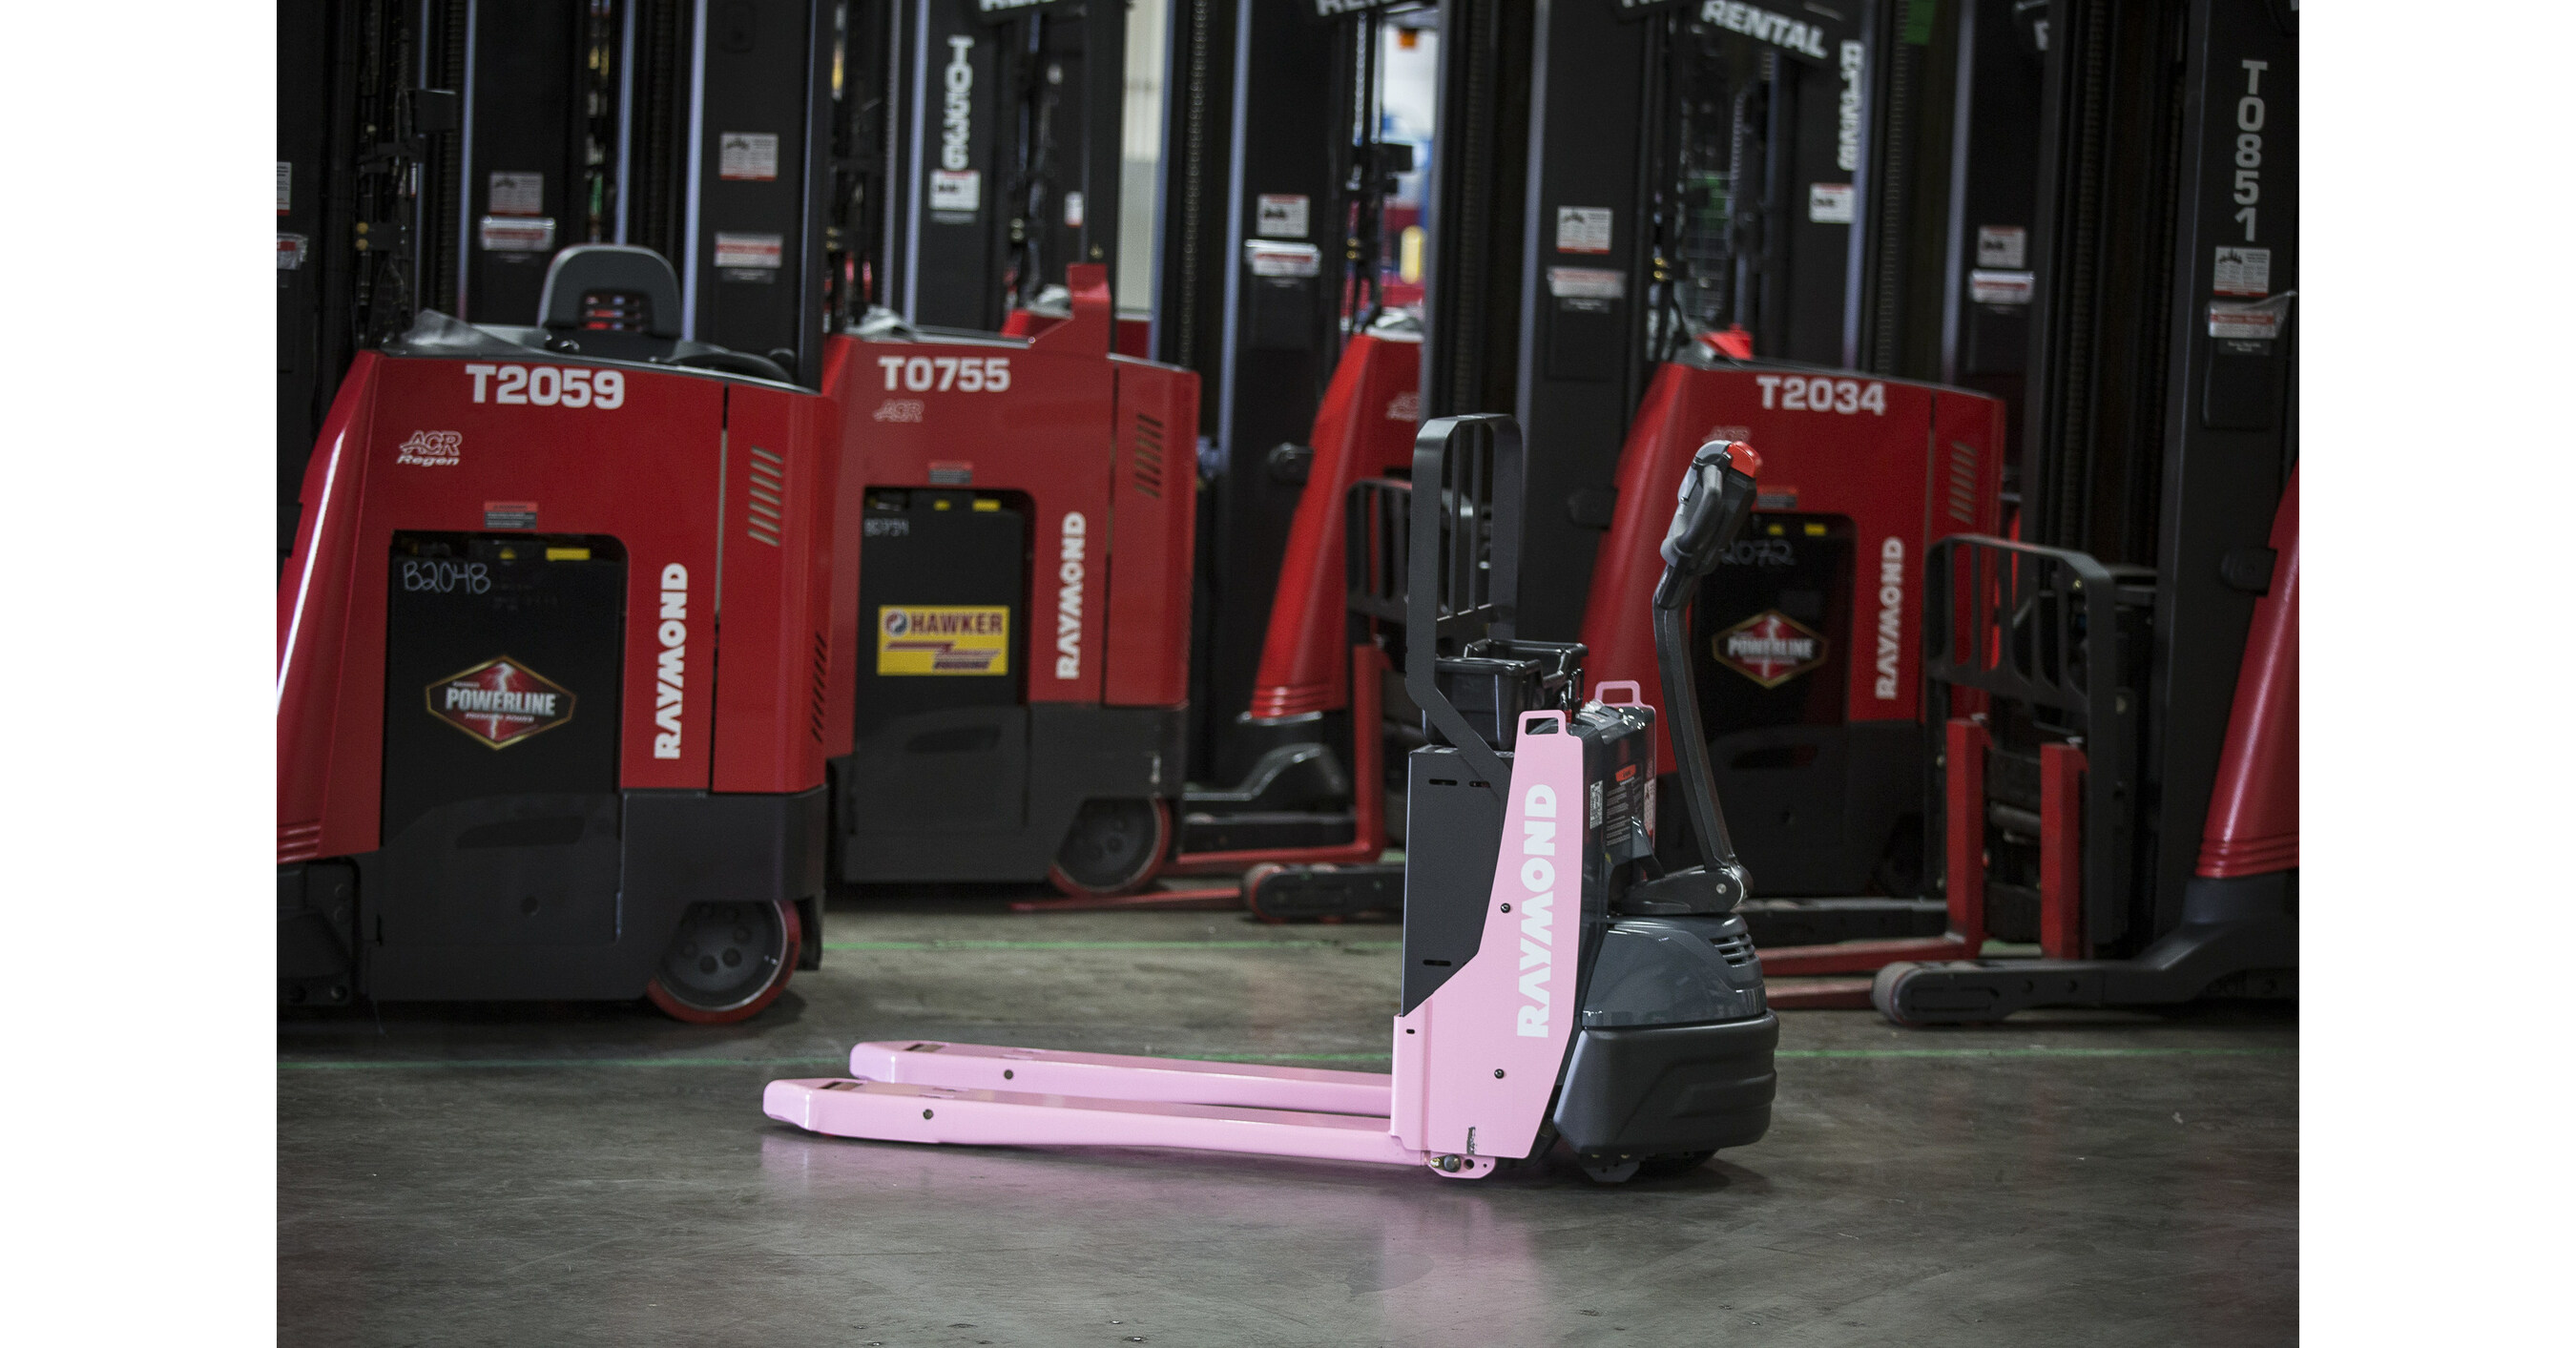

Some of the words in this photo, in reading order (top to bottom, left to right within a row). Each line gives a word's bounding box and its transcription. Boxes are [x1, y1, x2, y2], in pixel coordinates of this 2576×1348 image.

[1701, 0, 1828, 59] RENTAL
[2233, 59, 2268, 242] T0851
[466, 363, 625, 410] T2059
[878, 356, 1011, 393] T0755
[1755, 376, 1886, 416] T2034
[397, 454, 460, 467] Regen
[400, 430, 463, 456] ACR
[403, 561, 491, 595] B2048
[1055, 511, 1088, 680] RAYMOND
[910, 611, 1003, 635] HAWKER
[1875, 536, 1904, 701] RAYMOND
[654, 563, 688, 759] RAYMOND
[446, 686, 557, 717] POWERLINE
[1517, 783, 1557, 1039] RAYMOND
